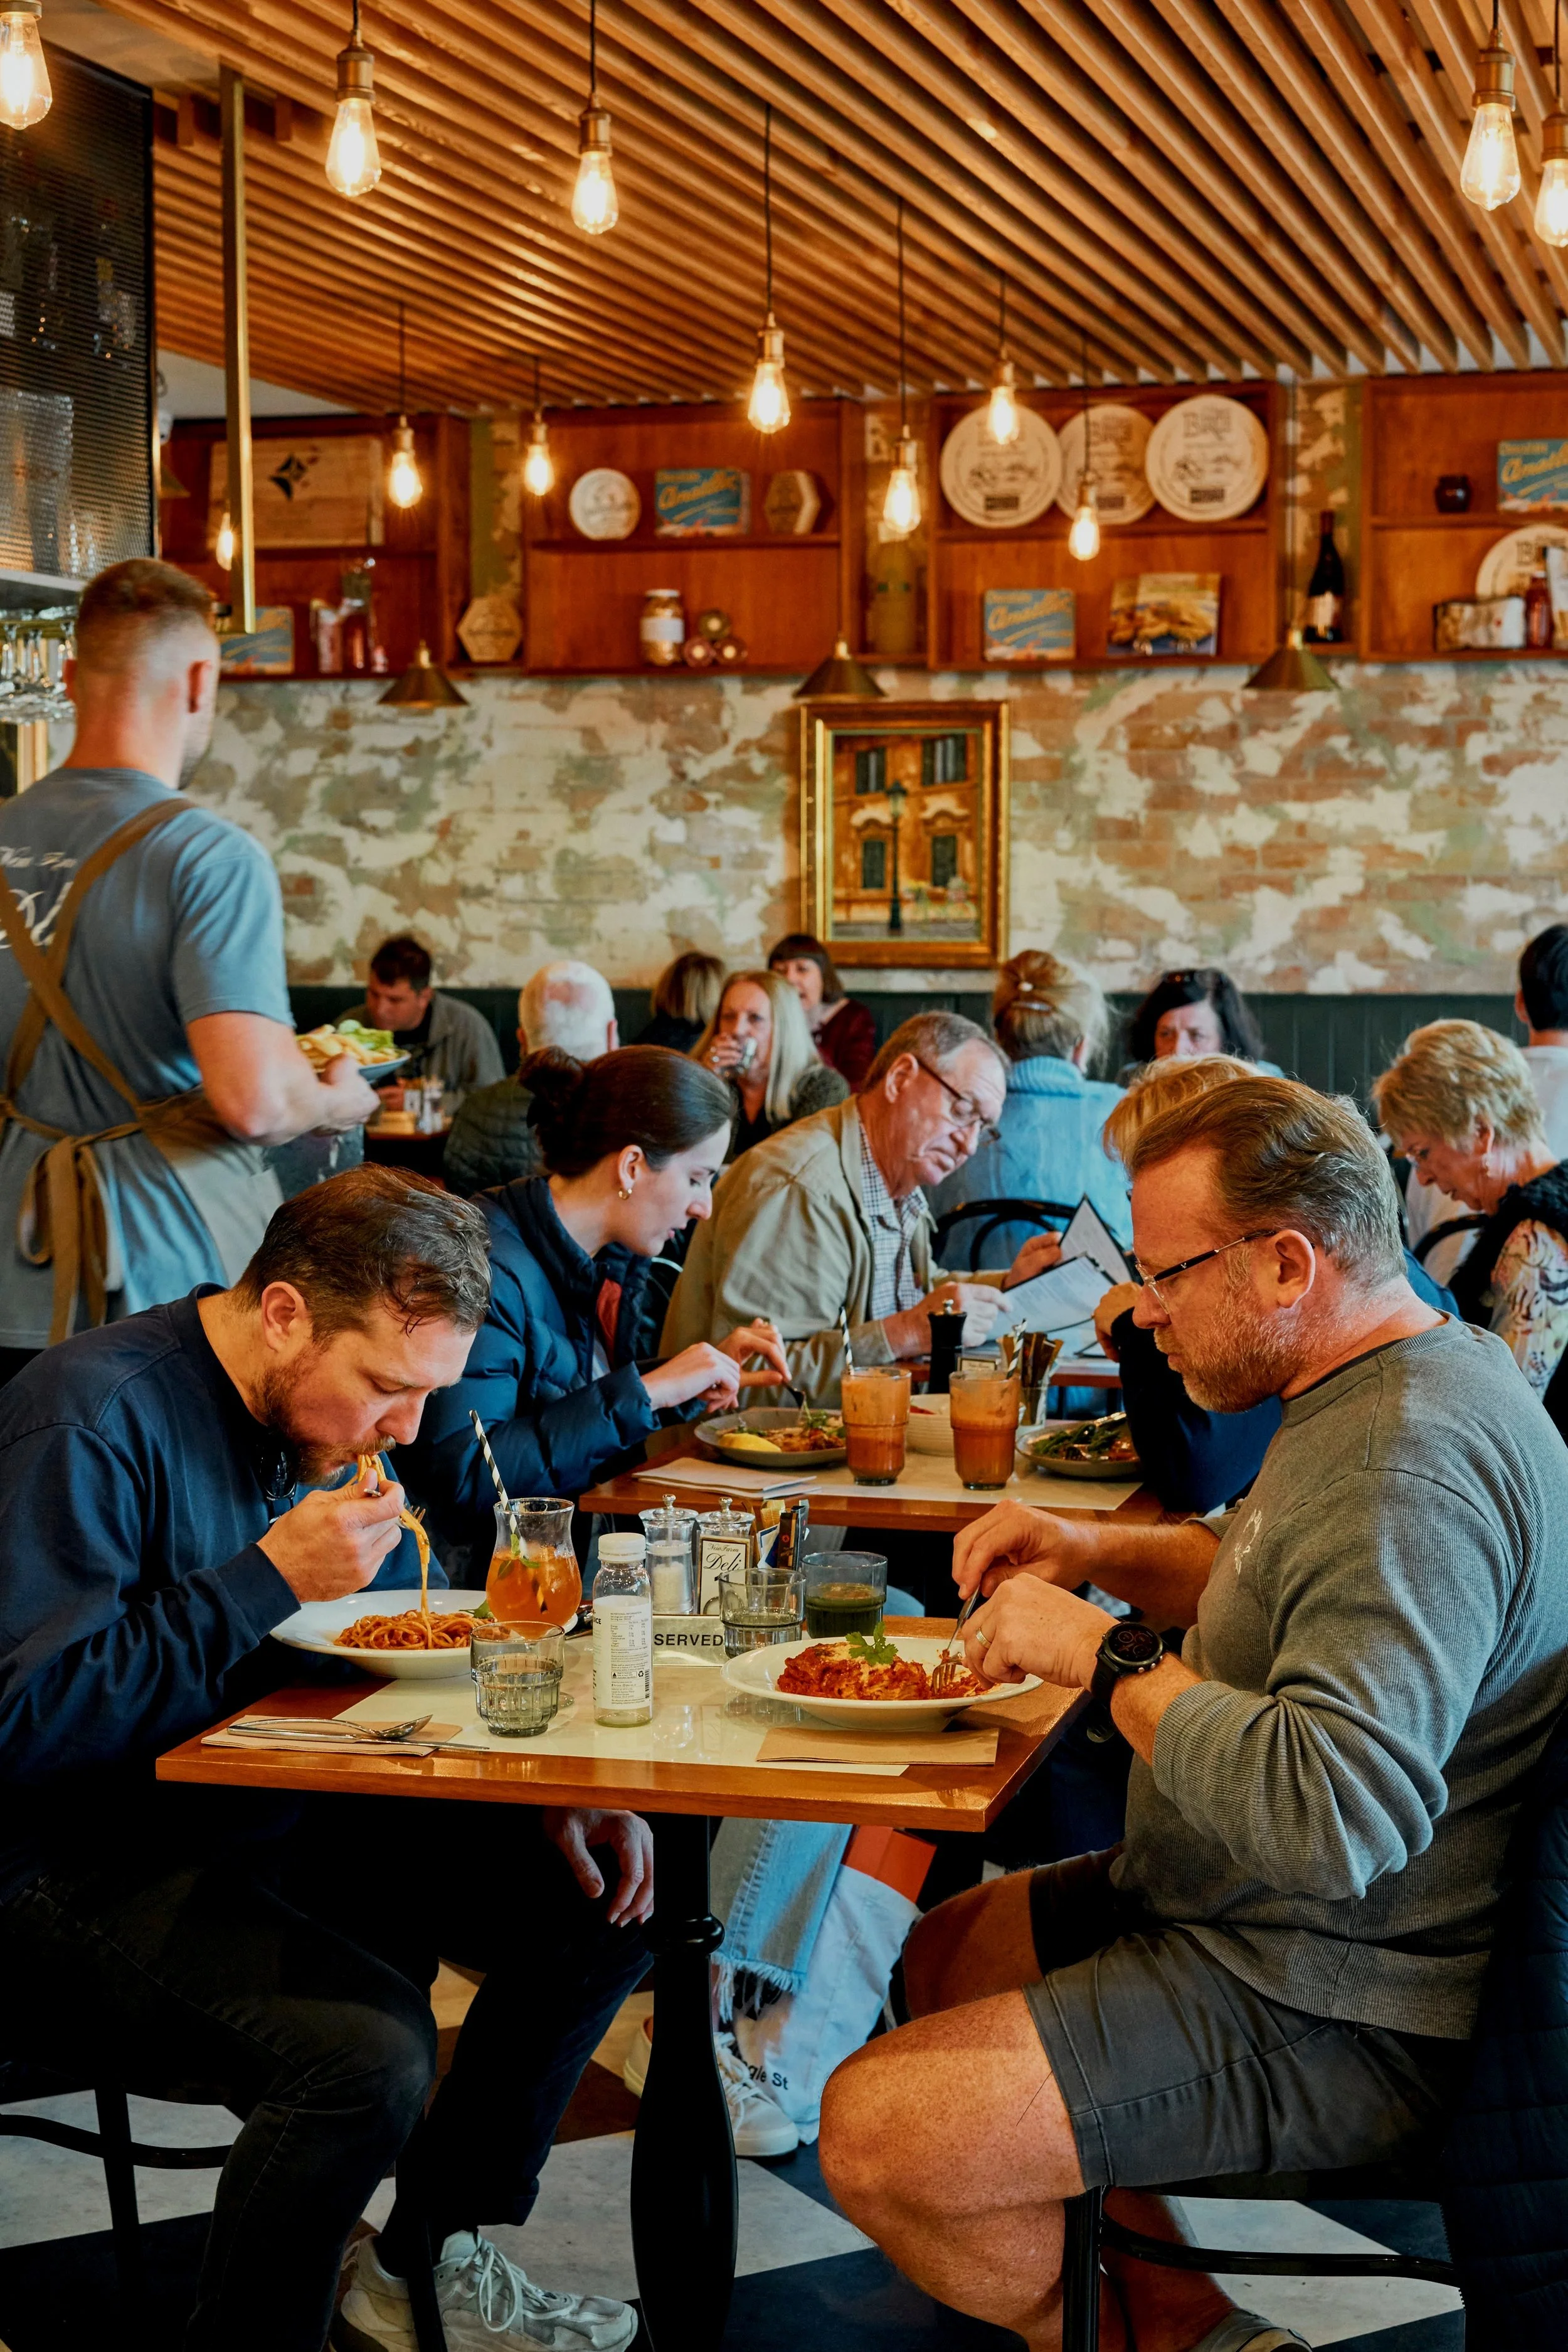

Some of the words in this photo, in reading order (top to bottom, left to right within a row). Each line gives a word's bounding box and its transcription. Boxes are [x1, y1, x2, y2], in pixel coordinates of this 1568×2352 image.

[703, 1553, 741, 1571] Deli
[654, 1634, 724, 1646] SERVED
[772, 2072, 788, 2090] St
